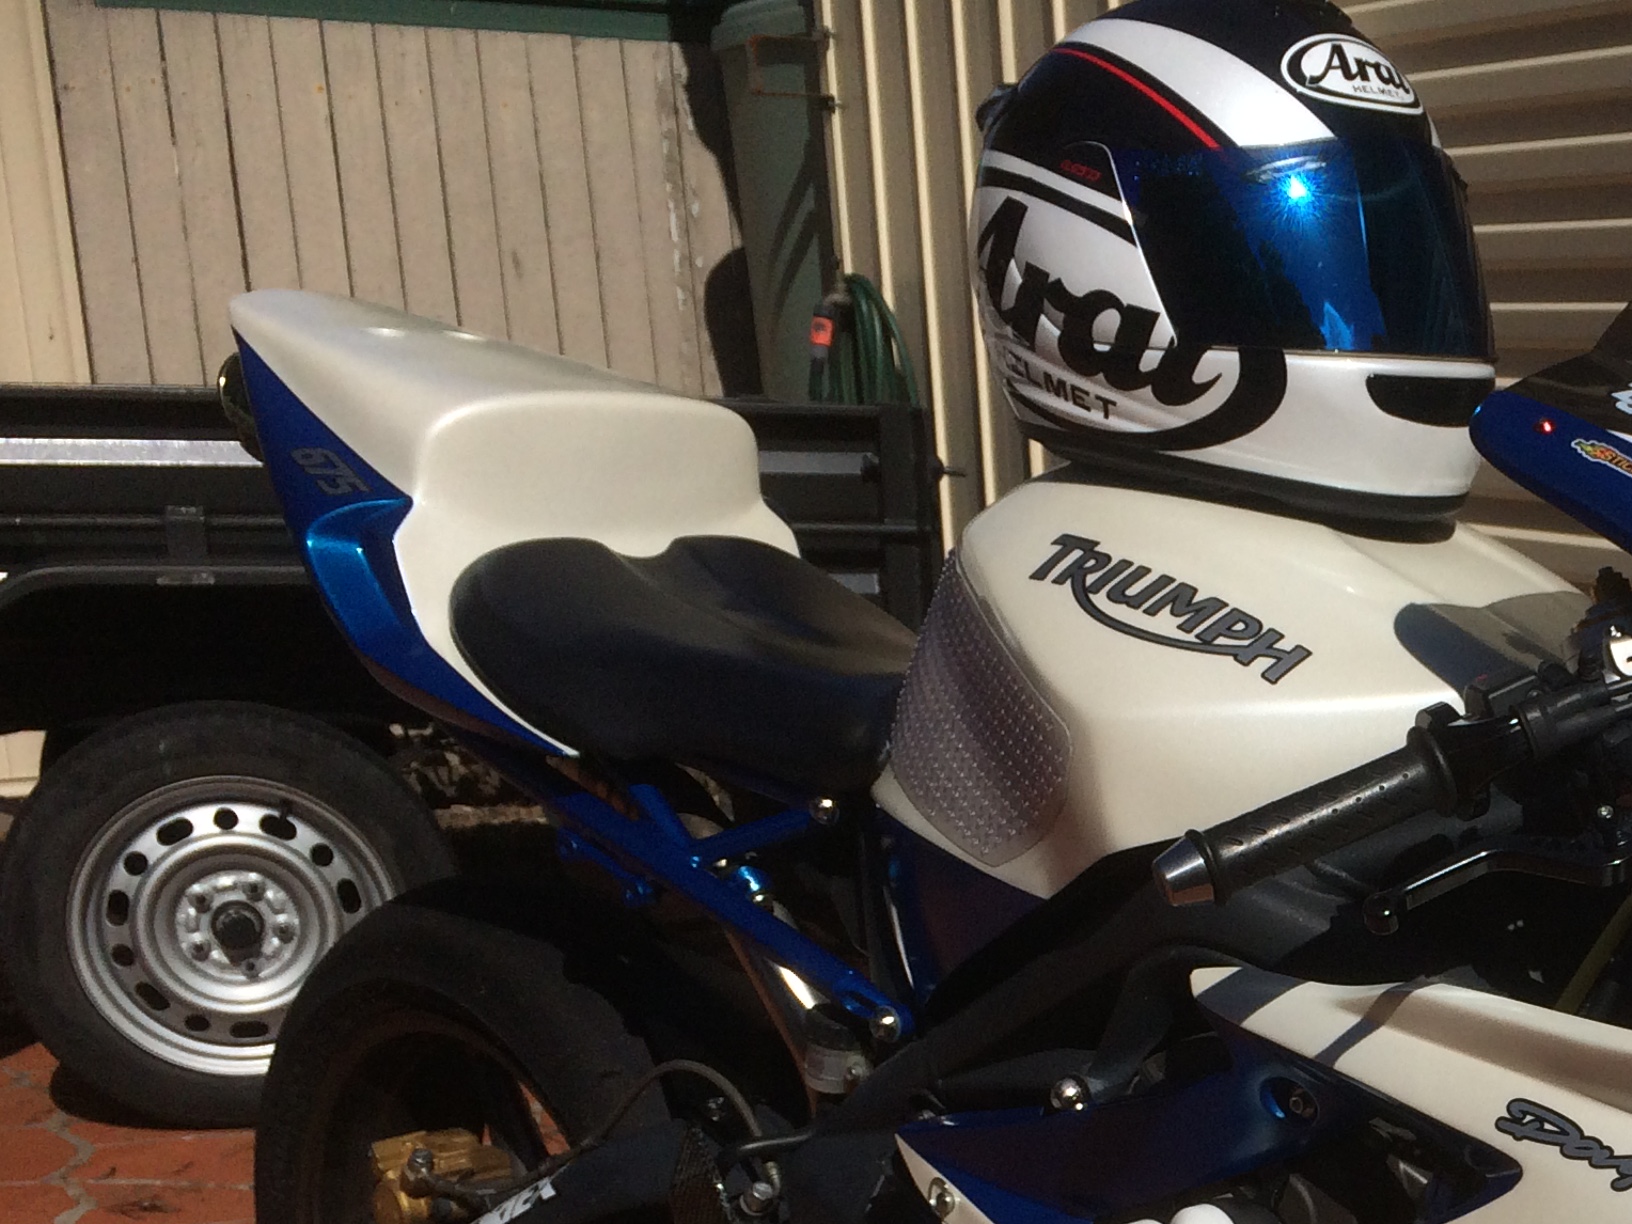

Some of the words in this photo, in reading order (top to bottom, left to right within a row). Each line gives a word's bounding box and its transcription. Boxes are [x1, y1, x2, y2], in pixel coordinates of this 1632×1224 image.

[1004, 348, 1117, 420] ELMET
[290, 447, 373, 496] 675
[1029, 533, 1313, 685] TRIUMPH
